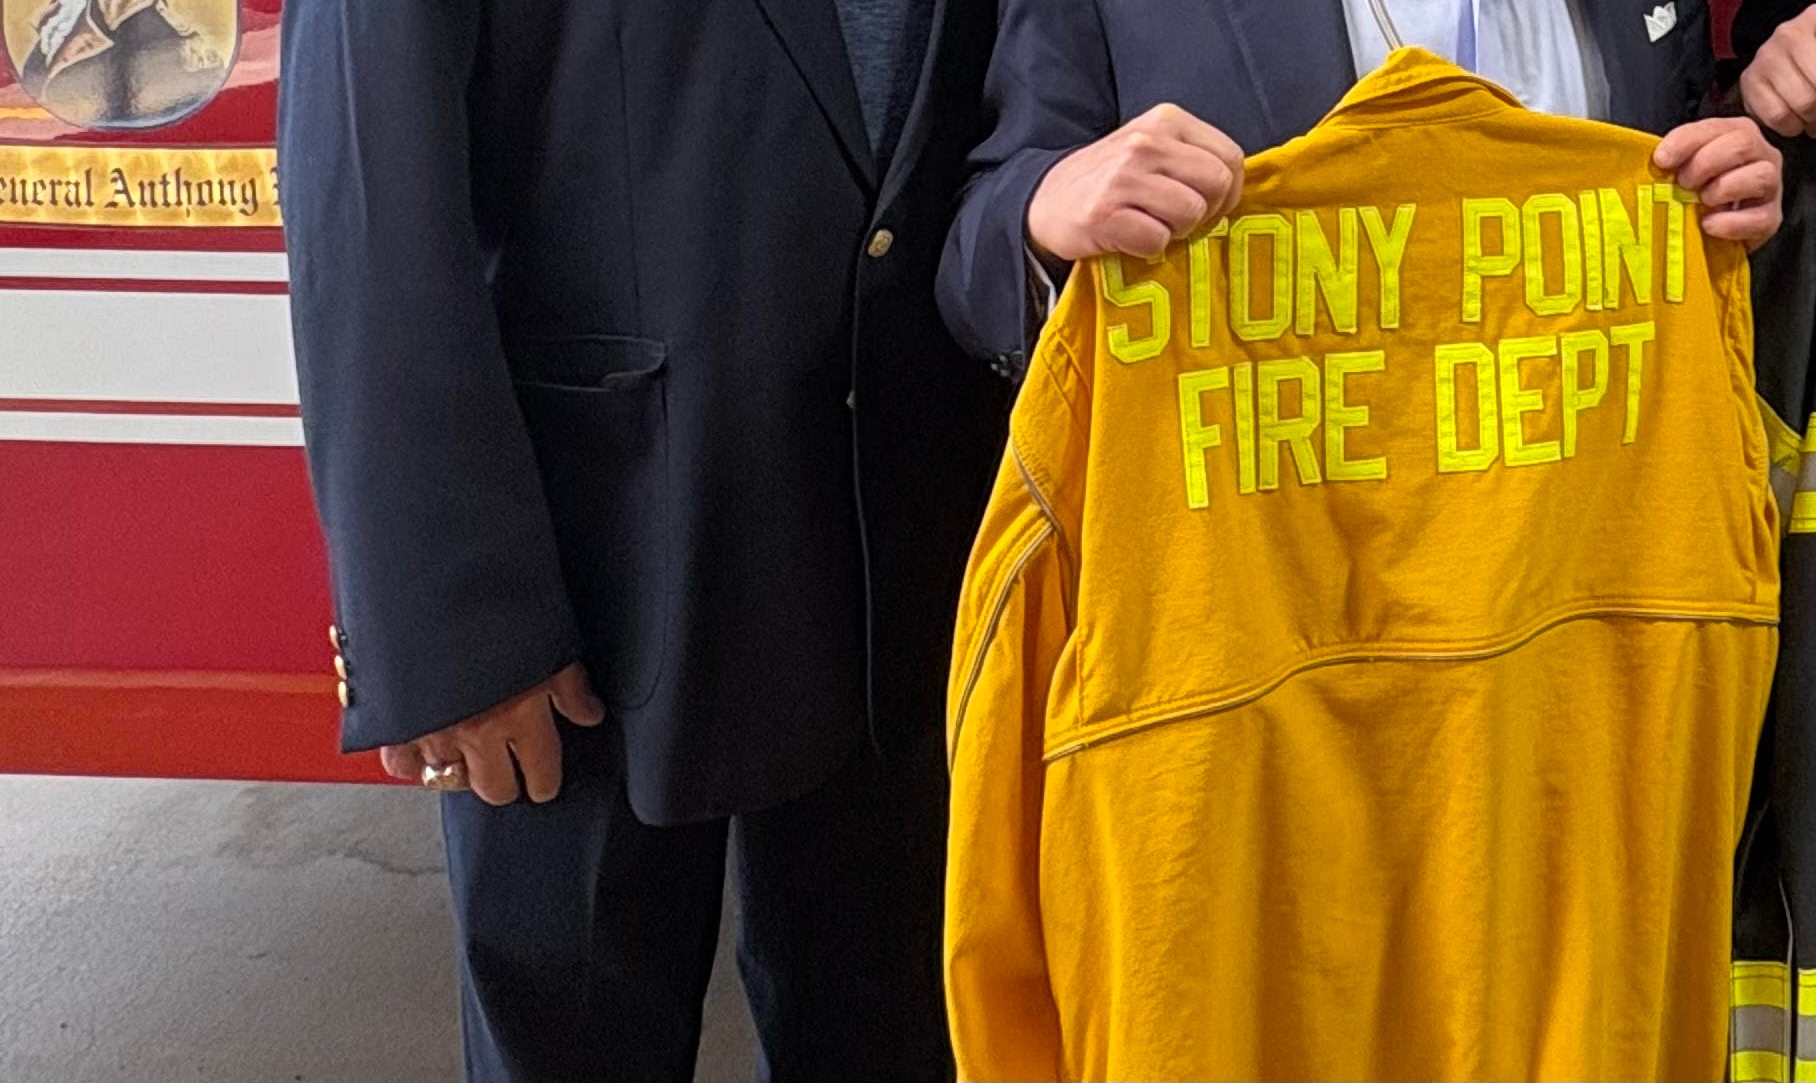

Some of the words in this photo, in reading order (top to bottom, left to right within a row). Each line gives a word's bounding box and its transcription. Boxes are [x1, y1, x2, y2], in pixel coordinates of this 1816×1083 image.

[104, 166, 259, 219] Anthony
[1101, 202, 1417, 364] STONY
[1460, 182, 1701, 326] POINT
[1178, 348, 1389, 511] FIRE
[1434, 320, 1656, 475] DEPT
